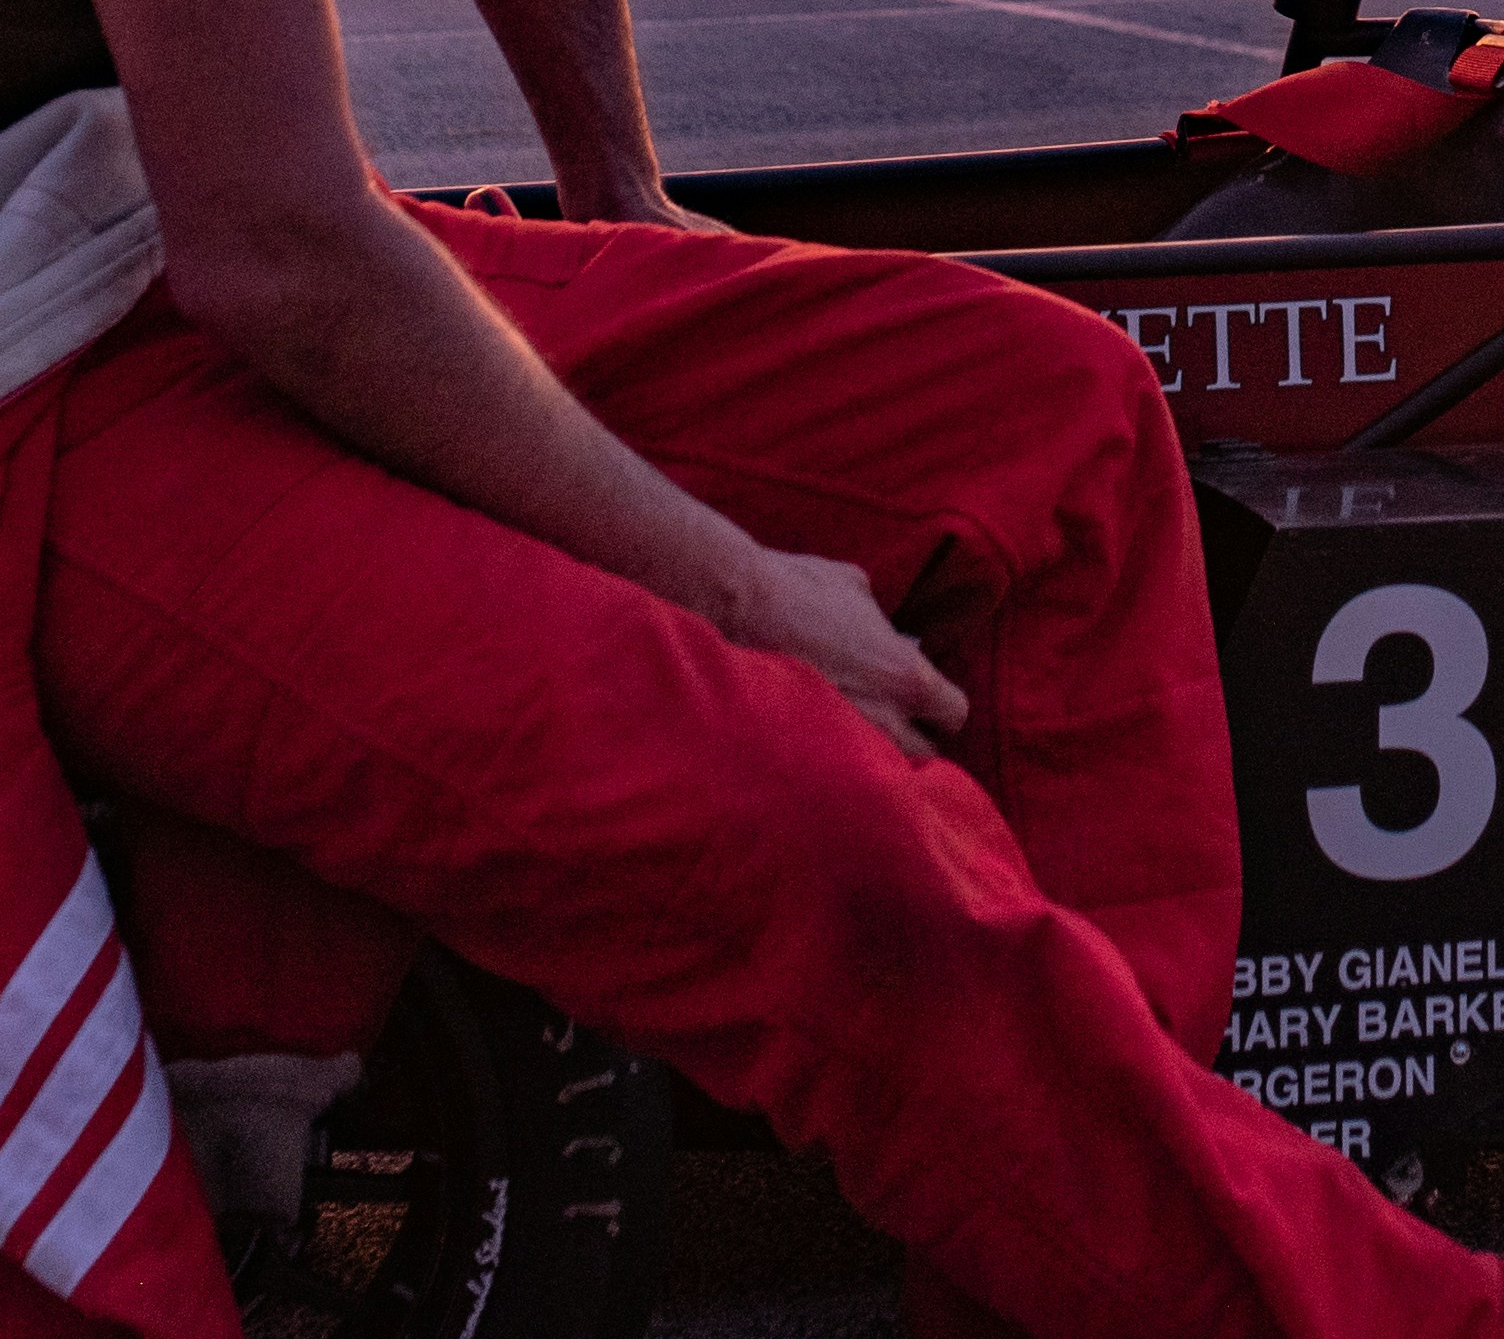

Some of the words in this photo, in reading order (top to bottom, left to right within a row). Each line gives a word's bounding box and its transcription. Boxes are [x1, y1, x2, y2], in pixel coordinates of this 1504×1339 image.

[1099, 294, 1398, 393] ETTE
[1216, 1054, 1437, 1108] RGERON
[1308, 1118, 1373, 1159] ER
